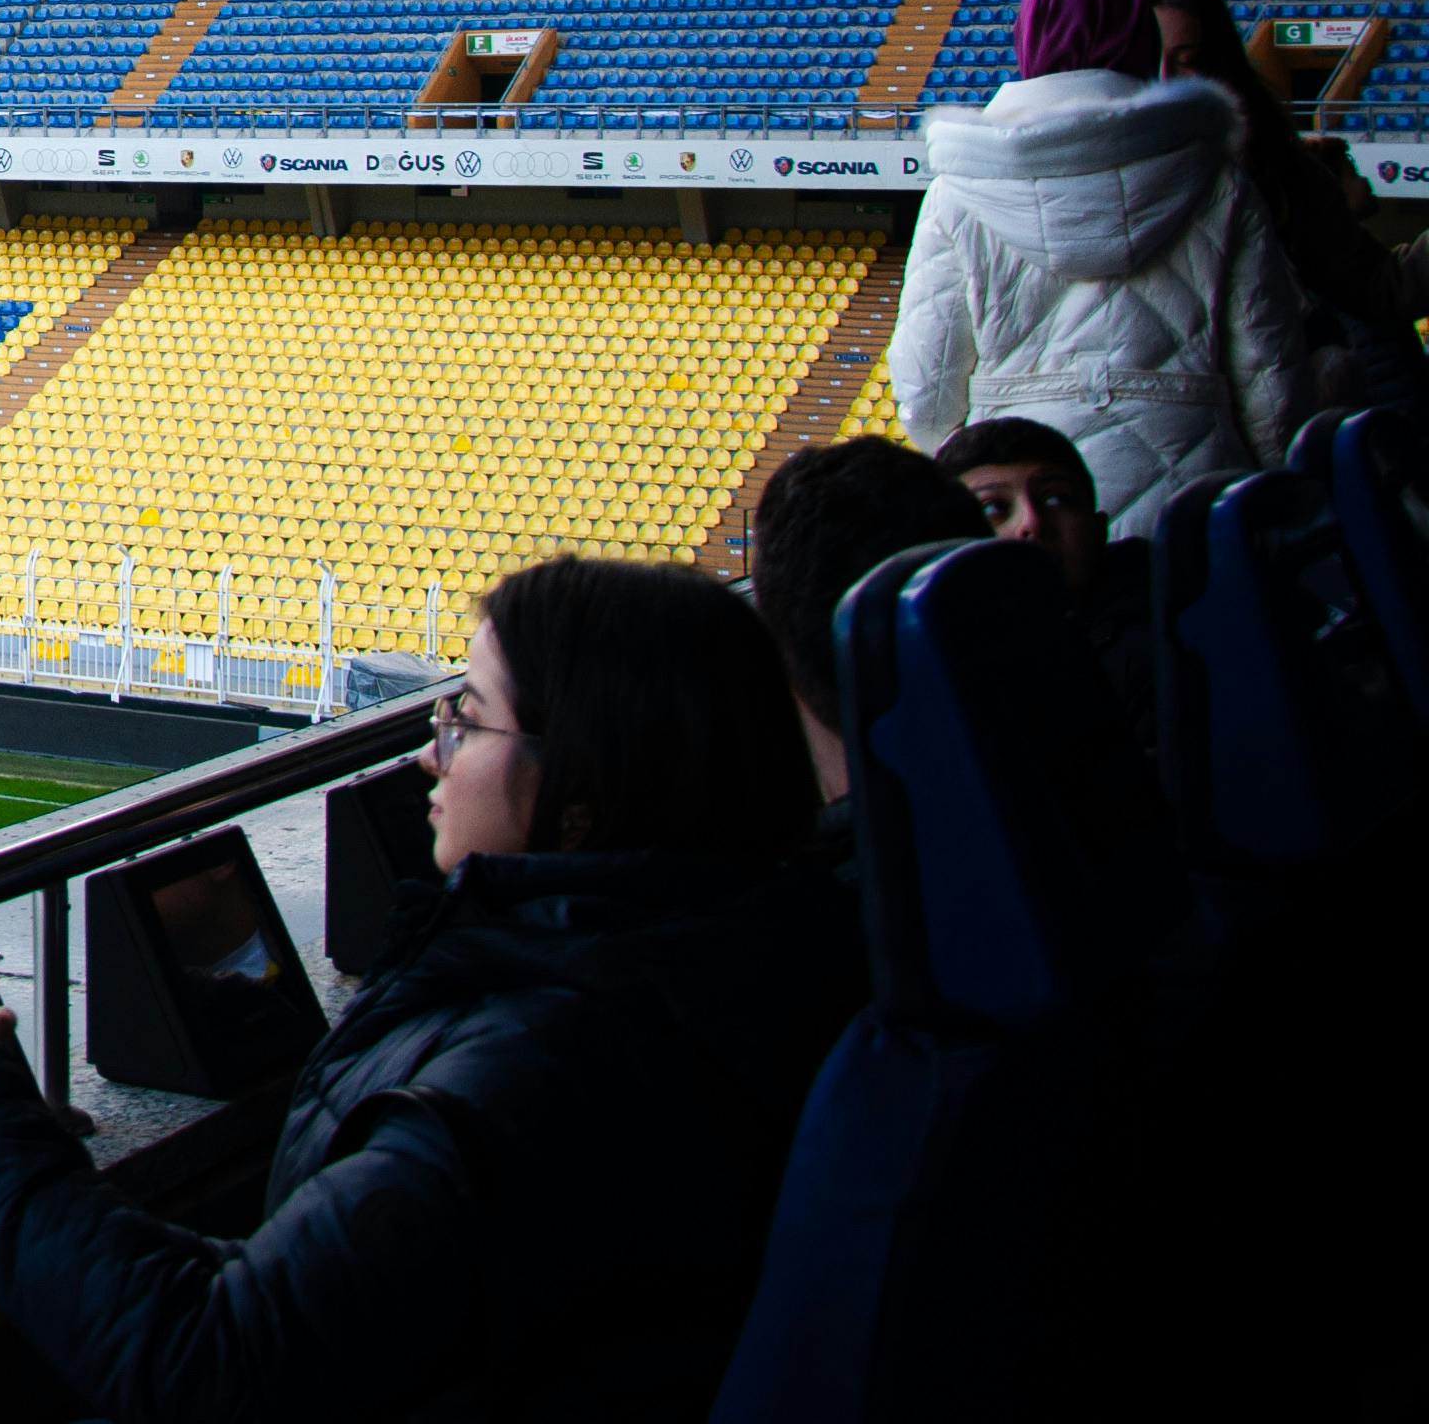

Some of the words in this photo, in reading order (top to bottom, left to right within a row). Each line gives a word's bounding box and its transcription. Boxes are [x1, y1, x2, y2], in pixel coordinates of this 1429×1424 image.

[1286, 25, 1301, 39] G
[474, 36, 484, 49] F
[280, 158, 348, 171] SCANIA
[797, 161, 879, 175] SCANIA
